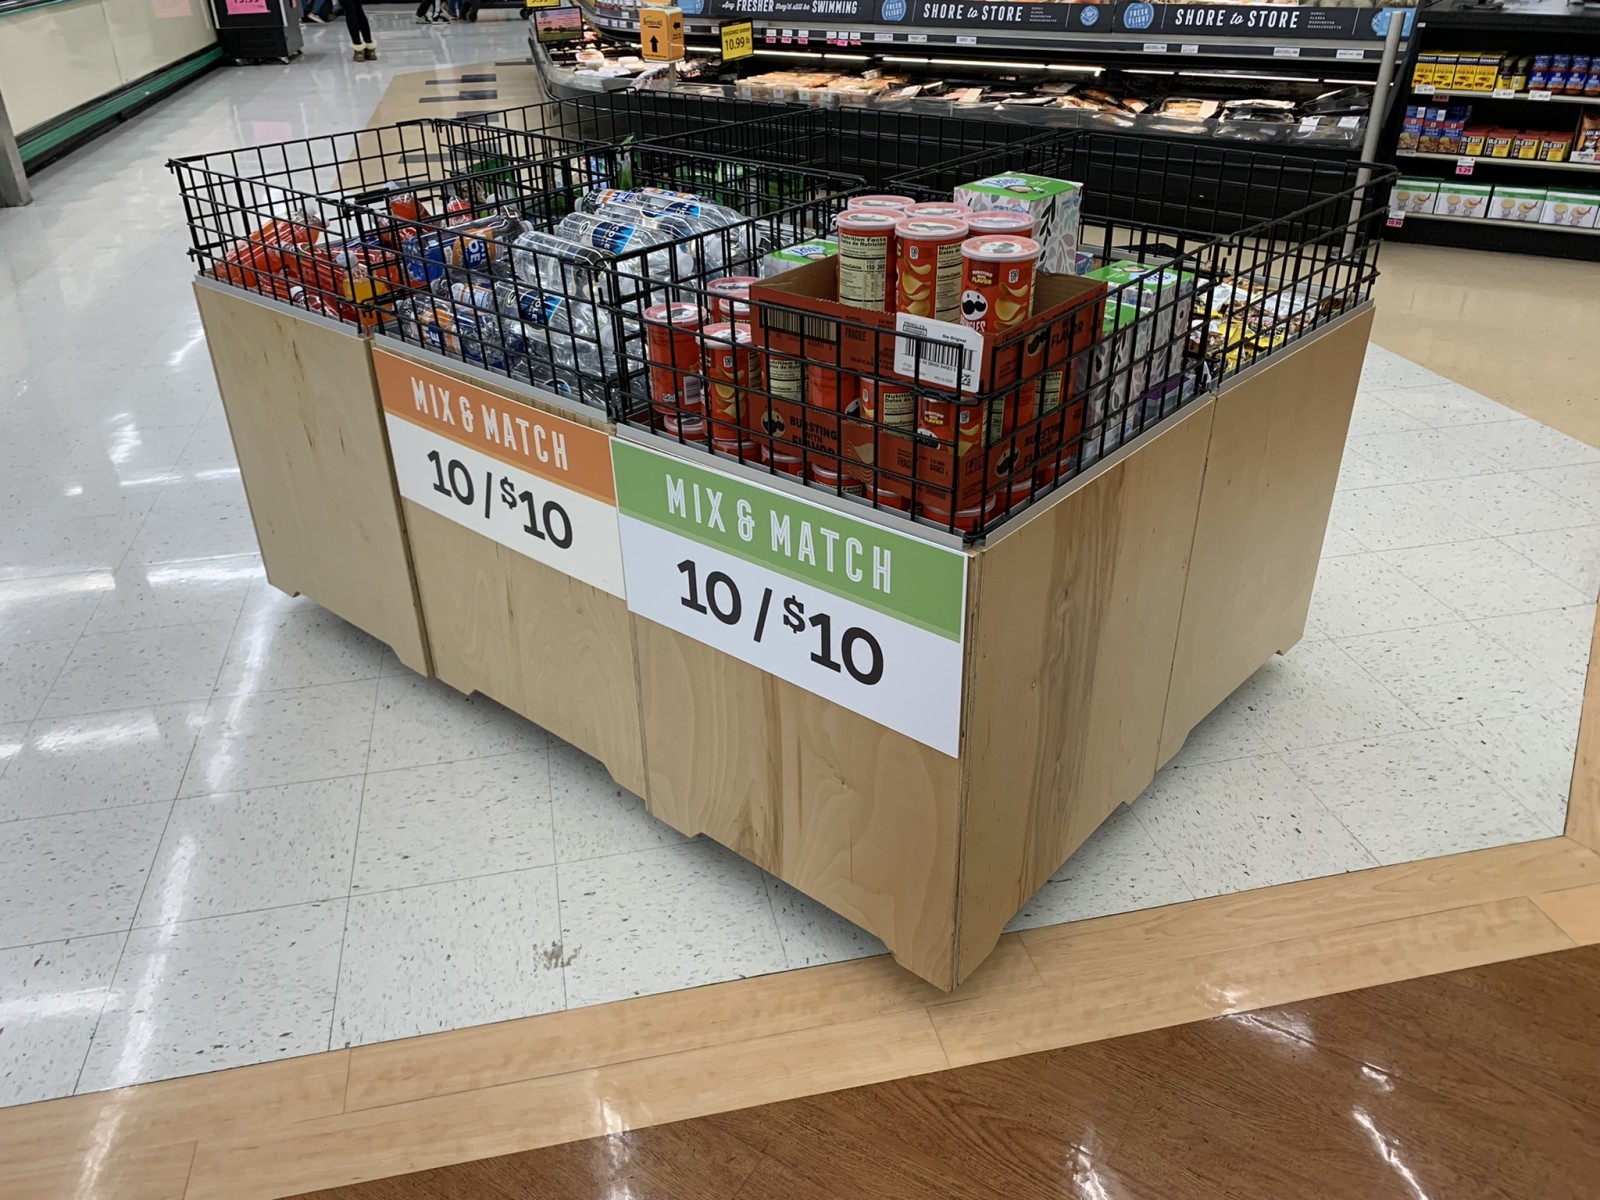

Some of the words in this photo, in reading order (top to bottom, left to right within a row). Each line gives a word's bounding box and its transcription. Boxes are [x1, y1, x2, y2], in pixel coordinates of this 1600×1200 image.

[736, 0, 774, 12] FRESHER
[812, 1, 858, 14] SWIMMING
[886, 2, 902, 10] FRESH
[923, 3, 964, 19] SHORE
[967, 6, 979, 18] to
[981, 5, 1023, 22] STORE
[1129, 8, 1149, 18] FRESH
[1128, 15, 1150, 24] FLIGHT
[1175, 8, 1226, 26] SHORE
[1229, 12, 1244, 25] to
[1247, 10, 1299, 29] STORE
[725, 36, 745, 51] 10.99
[971, 277, 993, 285] FLAVOR
[411, 376, 456, 426] MIX
[459, 395, 474, 433] &
[481, 404, 568, 471] MATCH
[789, 415, 838, 441] BUSTING
[665, 474, 726, 533] MIX
[736, 498, 755, 543] &
[770, 510, 891, 594] MATCH
